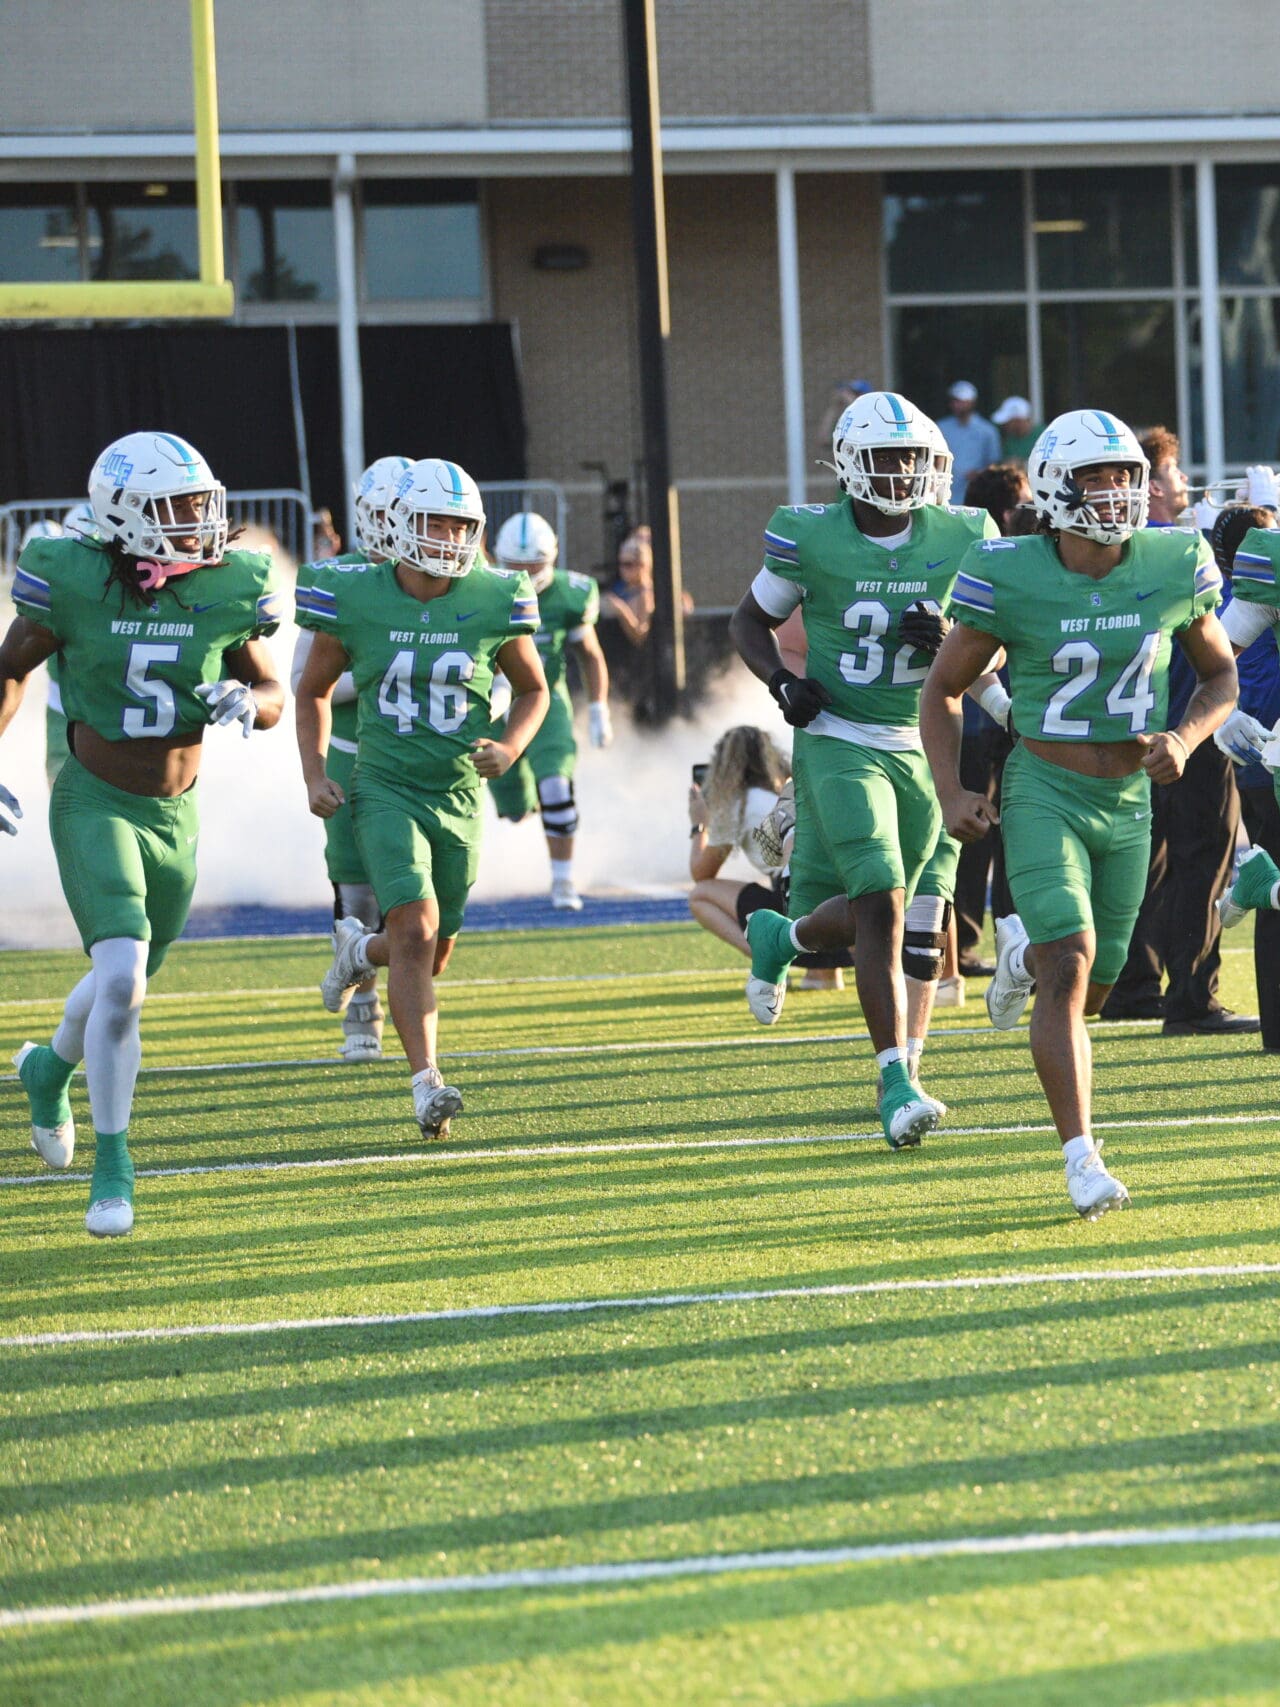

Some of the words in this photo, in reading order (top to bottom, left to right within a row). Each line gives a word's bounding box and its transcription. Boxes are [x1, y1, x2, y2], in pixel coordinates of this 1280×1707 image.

[856, 581, 882, 593] WEST
[886, 581, 928, 593] FLORIDA
[111, 620, 142, 635] WEST
[146, 622, 194, 637] FLORIDA
[1060, 618, 1090, 632] WEST
[1095, 613, 1141, 631] FLORIDA
[389, 630, 415, 643] WEST
[419, 632, 459, 644] FLORIDA
[122, 641, 182, 738] 5
[377, 649, 475, 734] 46
[1040, 631, 1161, 738] 24
